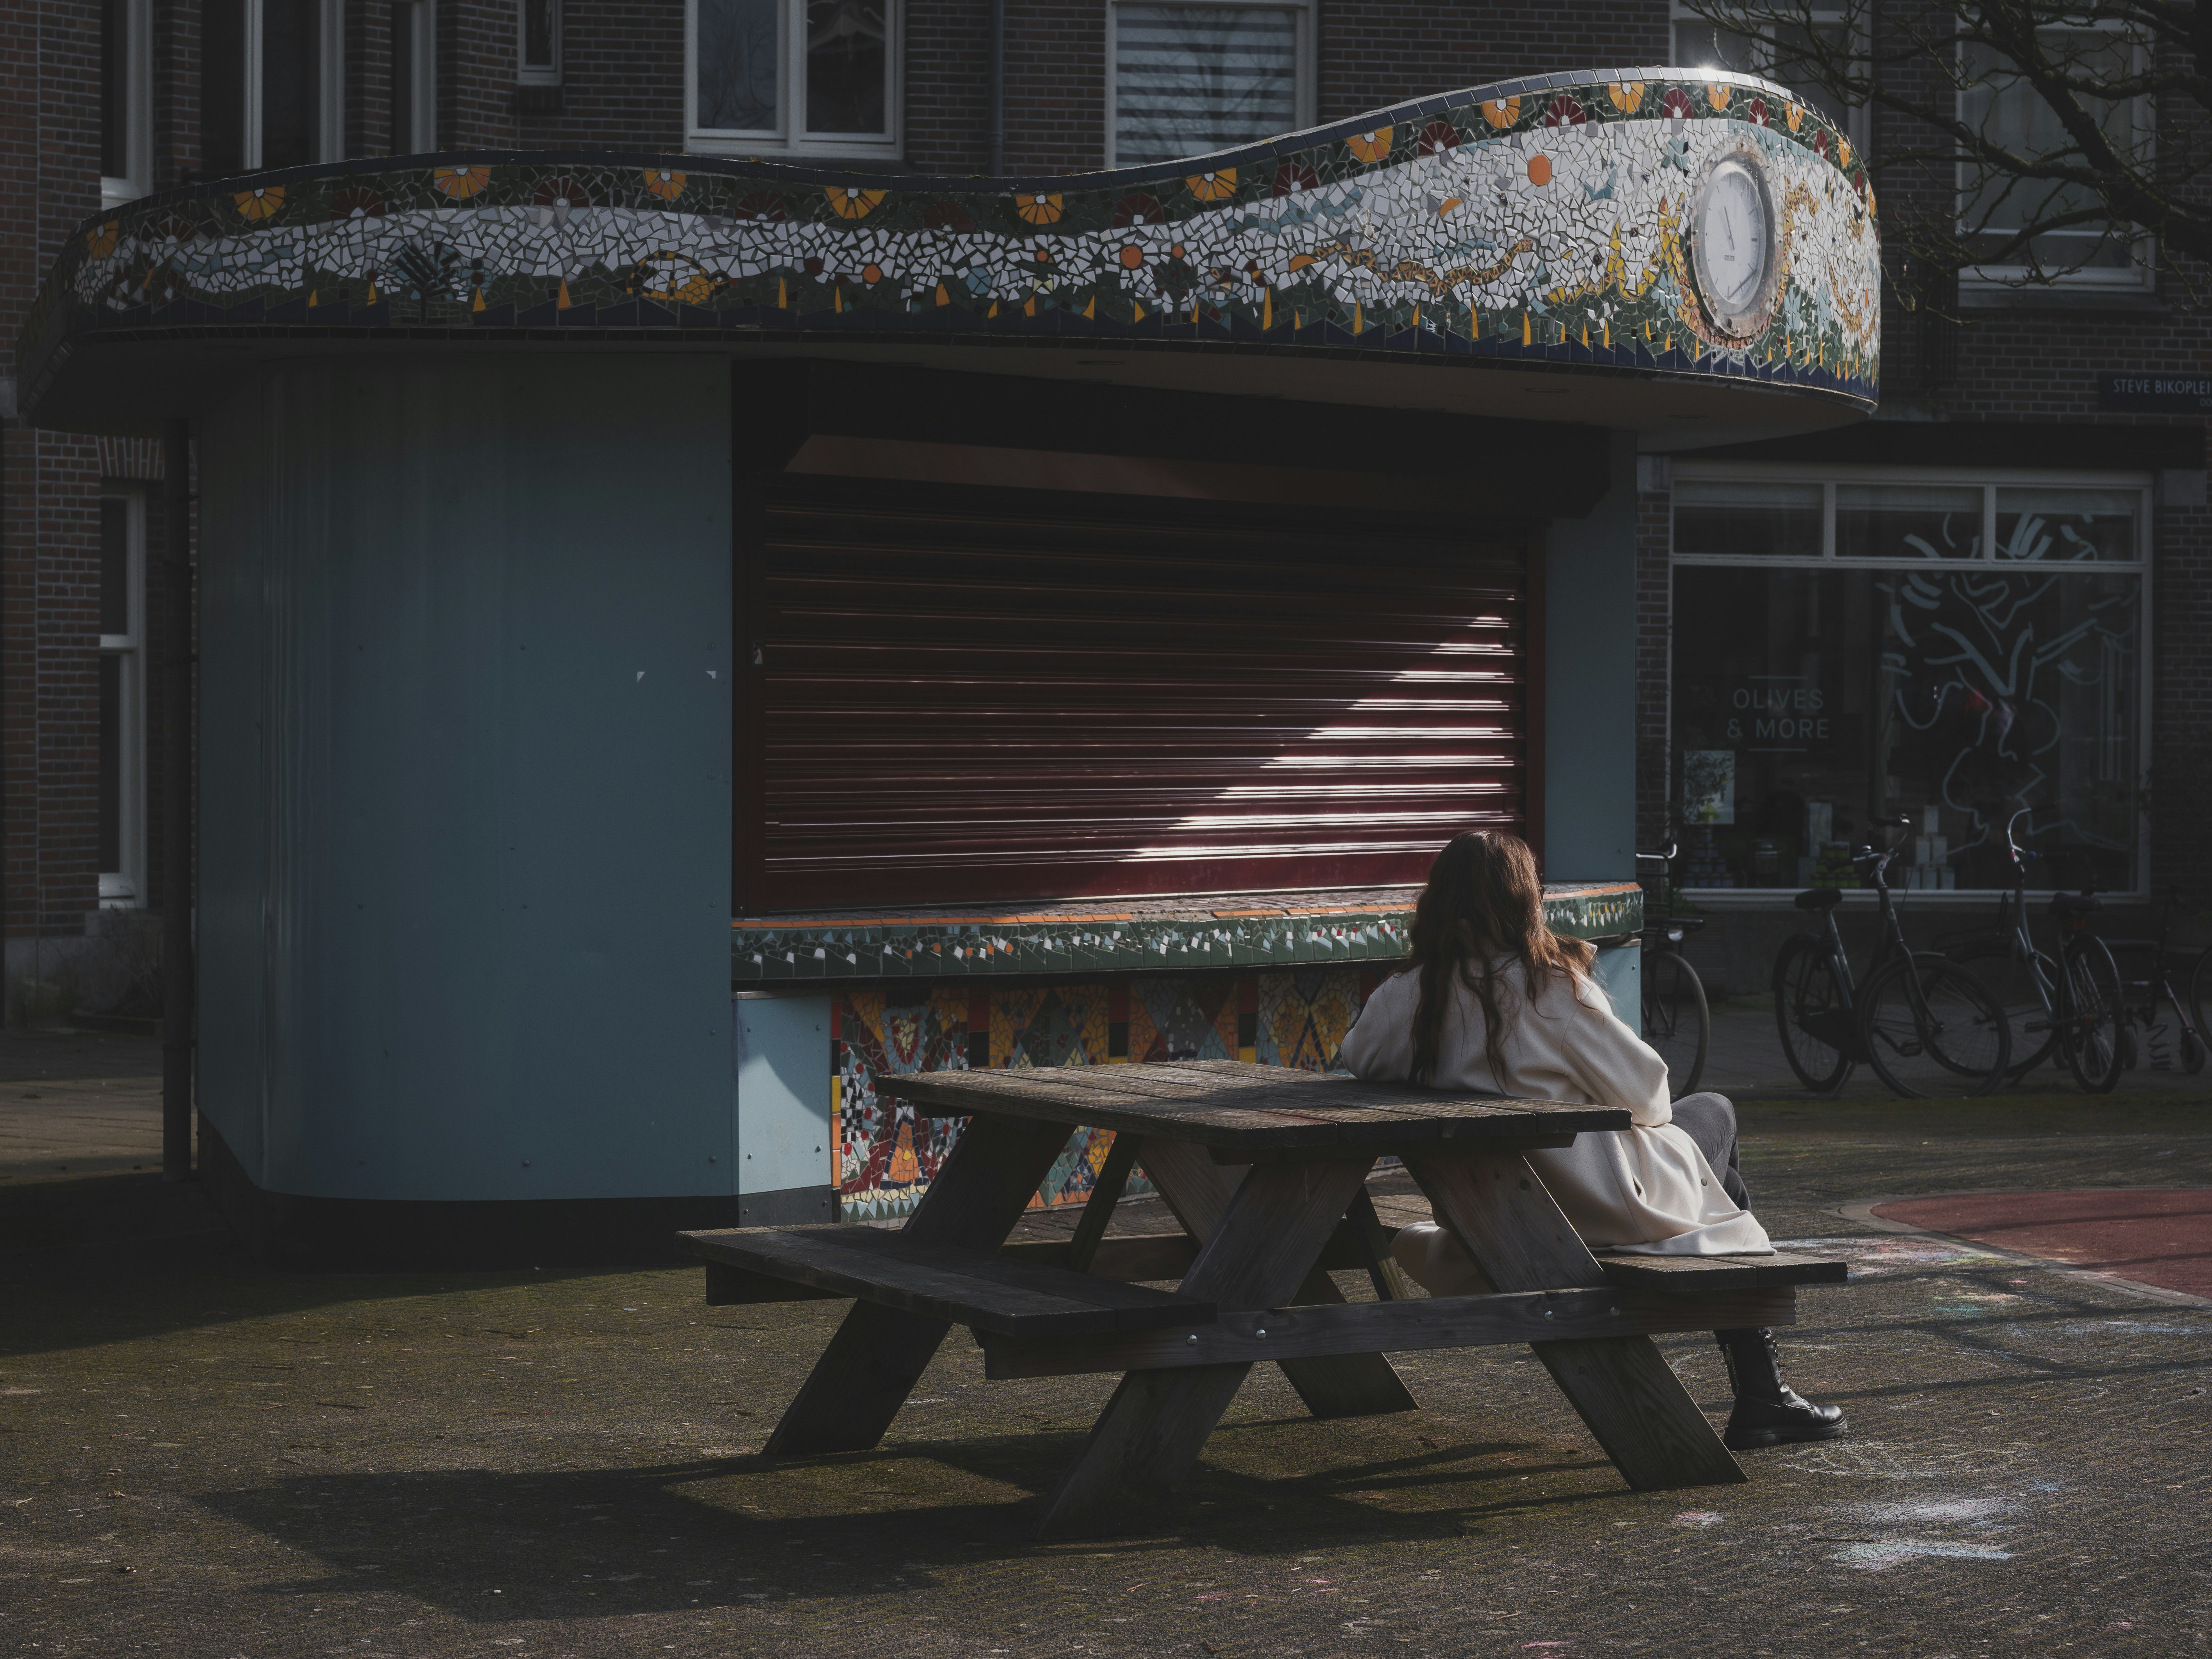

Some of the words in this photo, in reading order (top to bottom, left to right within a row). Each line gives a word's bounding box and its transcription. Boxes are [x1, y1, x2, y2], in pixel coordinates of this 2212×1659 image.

[2114, 379, 2150, 394] STEVE
[2155, 379, 2212, 395] BIKOPLEI
[2199, 397, 2212, 407] OO
[1733, 688, 1824, 709] OLIVES
[1727, 718, 1743, 738] &
[1756, 718, 1829, 739] MORE
